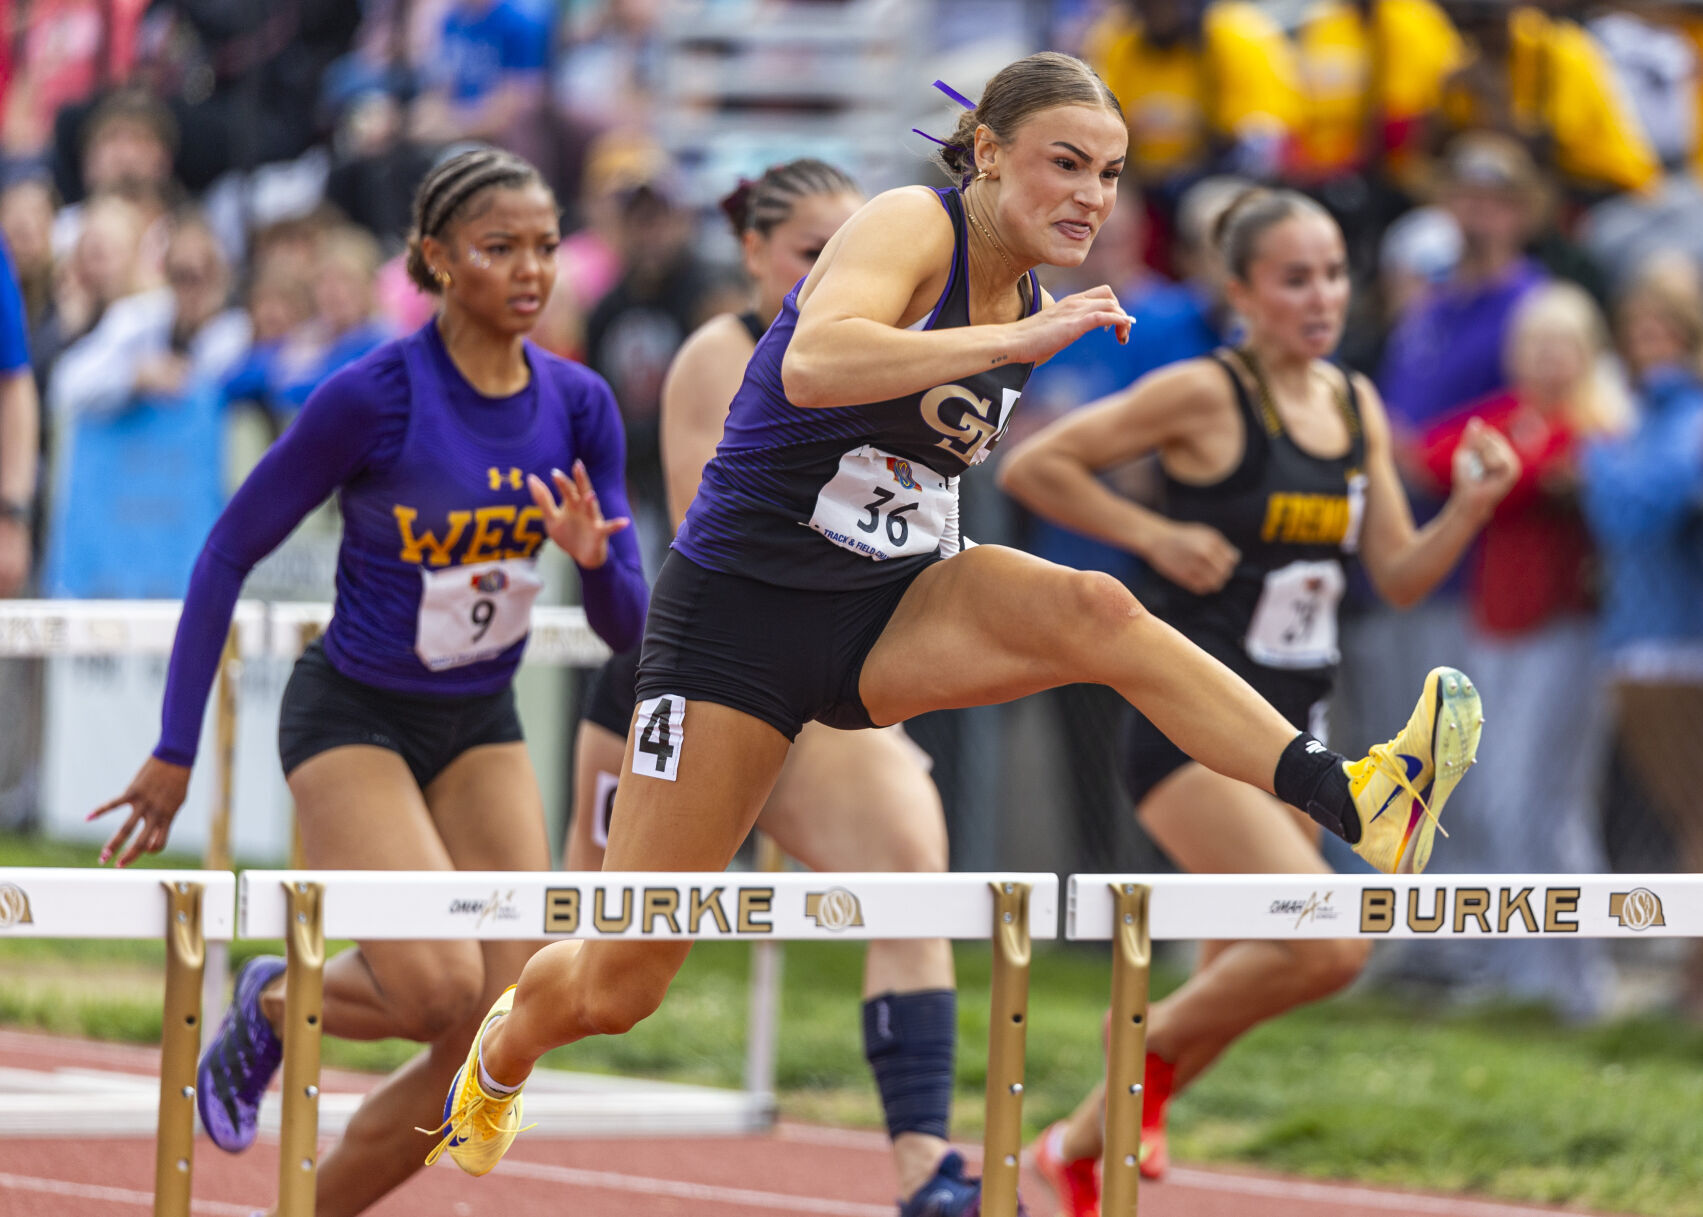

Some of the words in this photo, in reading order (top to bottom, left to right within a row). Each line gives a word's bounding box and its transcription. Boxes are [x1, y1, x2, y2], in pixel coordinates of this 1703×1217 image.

[393, 503, 546, 567] WES
[857, 487, 919, 547] 36
[824, 529, 850, 544] TRACK
[848, 538, 855, 547] &
[856, 541, 876, 555] FIELD
[470, 599, 495, 644] 9
[639, 697, 674, 773] 4
[544, 886, 775, 934] BURKE
[1359, 887, 1582, 934] BURKE
